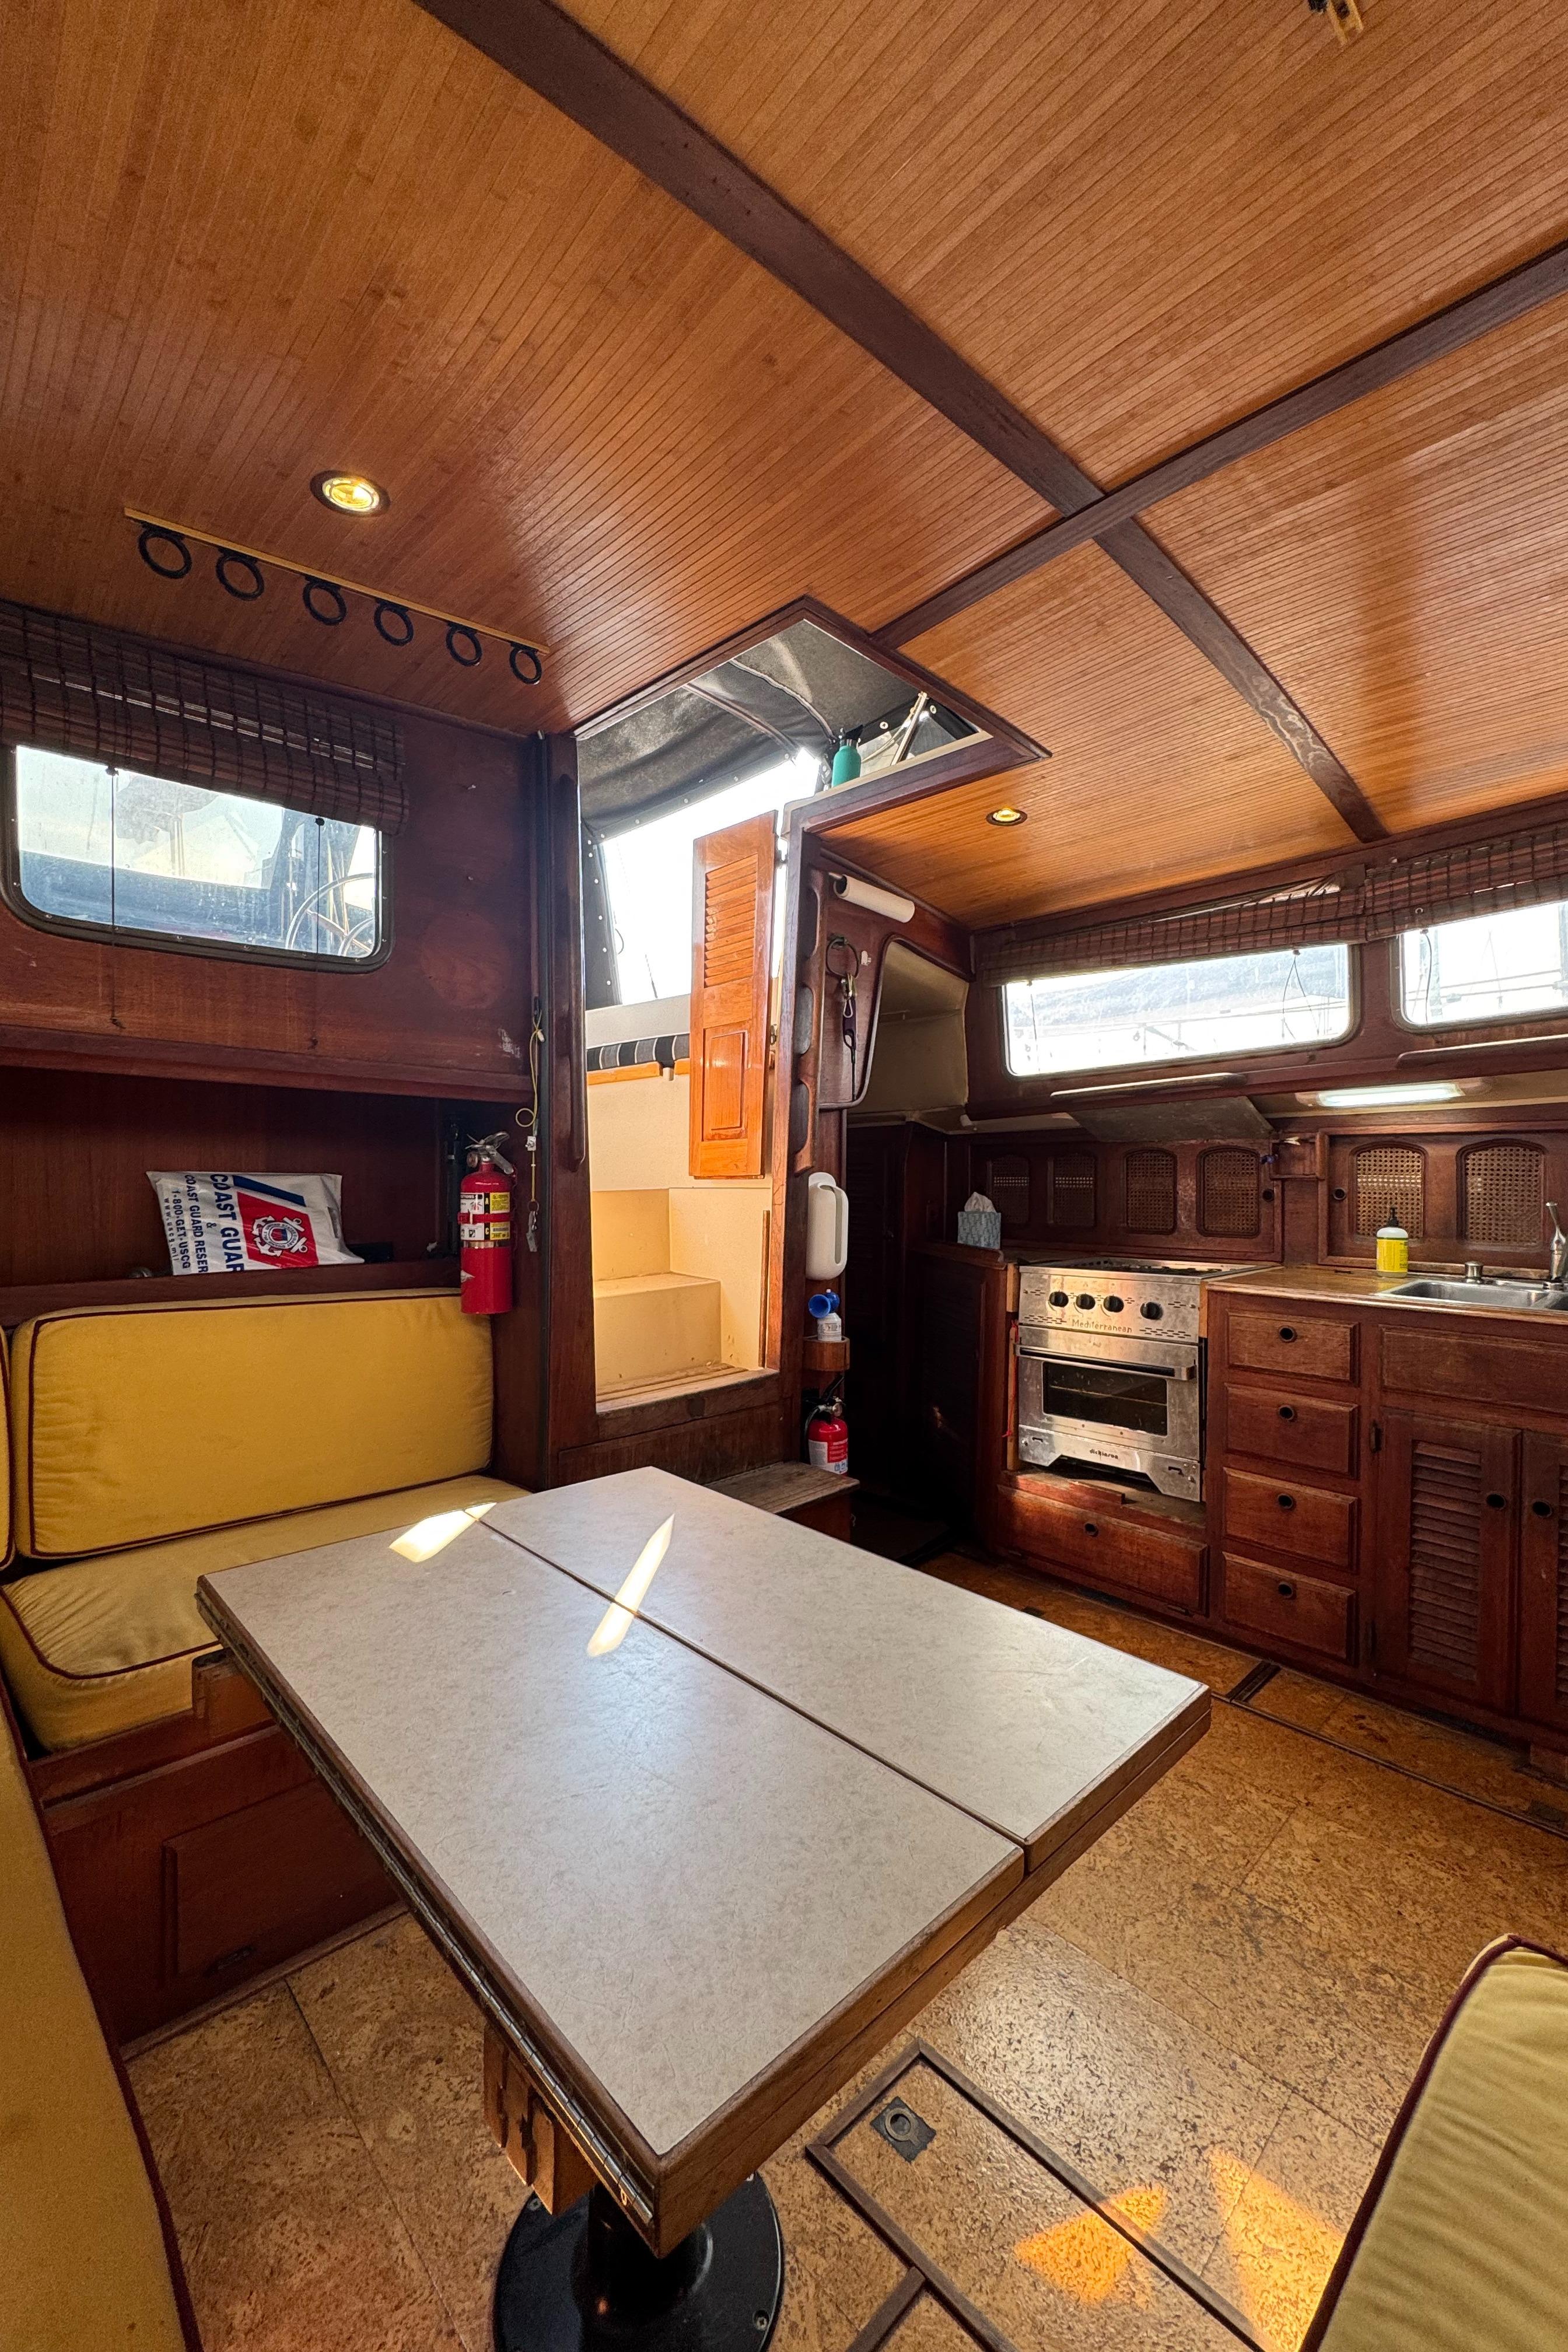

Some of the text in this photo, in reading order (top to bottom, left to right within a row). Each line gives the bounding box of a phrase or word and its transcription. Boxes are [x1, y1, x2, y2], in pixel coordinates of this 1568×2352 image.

[211, 1174, 237, 1220] COAST
[184, 1174, 208, 1272] COAST GUARD RESER
[1072, 1319, 1132, 1333] Mediterranean
